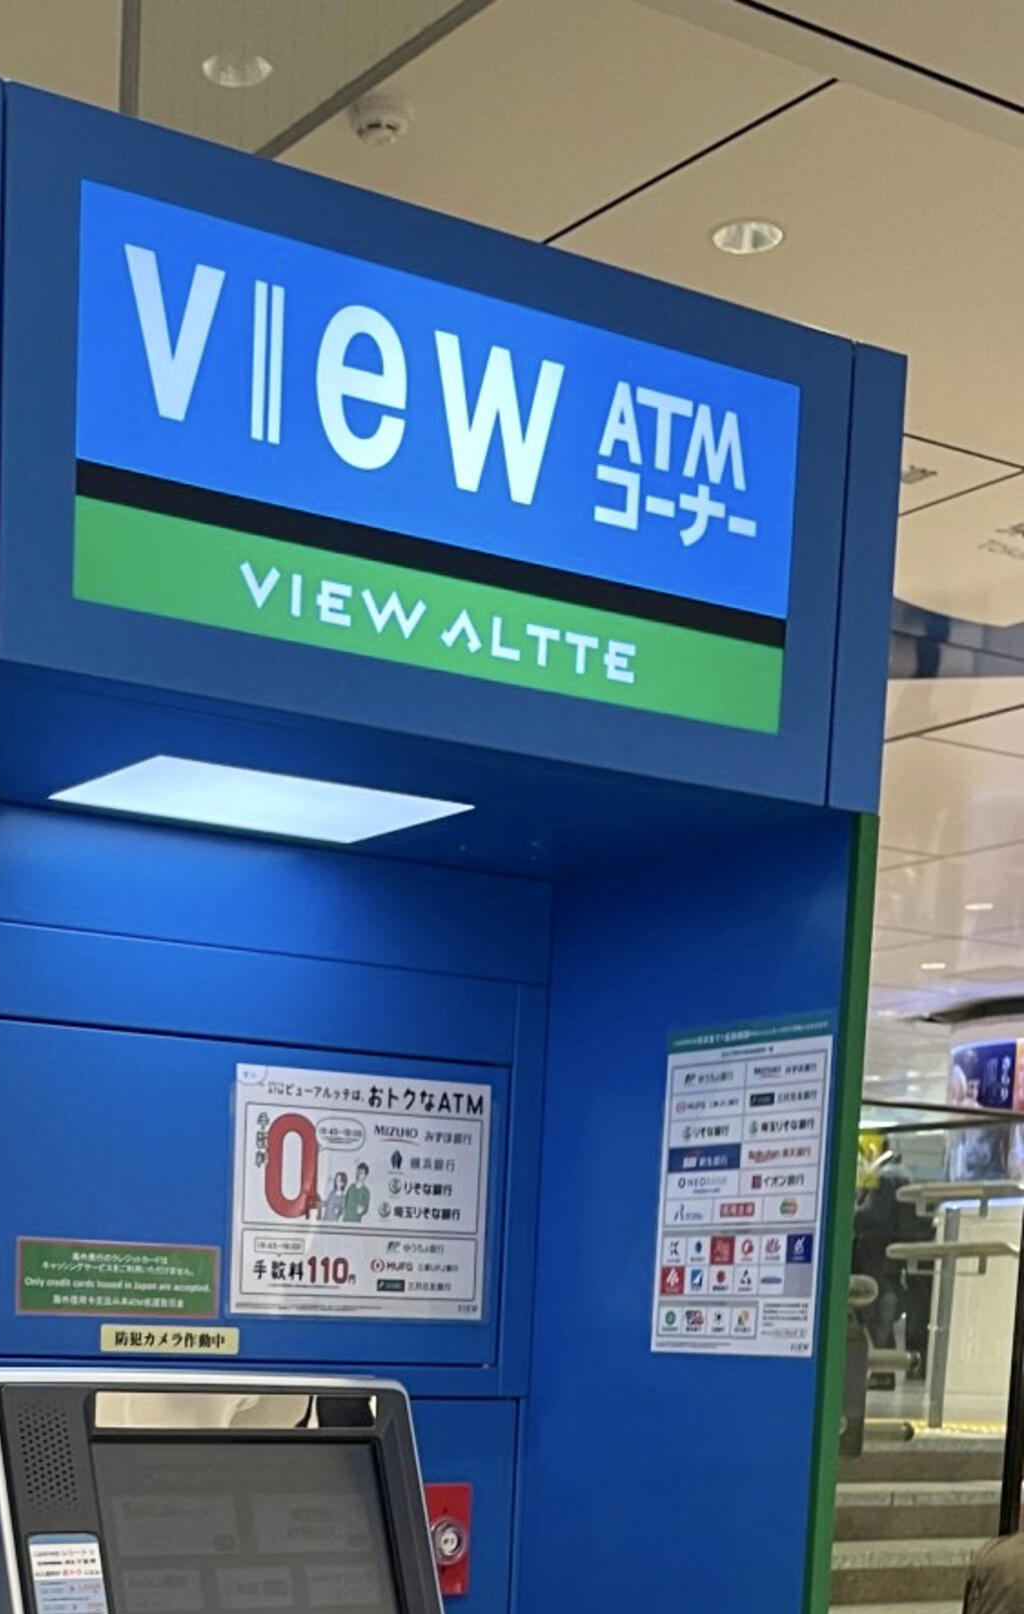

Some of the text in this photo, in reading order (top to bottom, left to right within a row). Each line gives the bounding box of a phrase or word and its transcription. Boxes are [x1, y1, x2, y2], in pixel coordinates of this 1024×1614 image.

[598, 381, 746, 491] ATM
[593, 464, 758, 547] コーナー
[239, 561, 636, 684] VIEW ALTTE
[368, 1085, 484, 1116] おトクなATM
[374, 1124, 418, 1138] MIZUHO
[410, 1157, 456, 1172] 横浜銀行
[404, 1183, 453, 1197] りそな銀行
[394, 1206, 461, 1221] 埼玉りそな銀行
[24, 1277, 44, 1288] Only
[46, 1278, 70, 1288] credit
[73, 1279, 95, 1288] cards
[97, 1280, 123, 1289] issued
[134, 1282, 156, 1291] Japan
[114, 1331, 225, 1349] 防犯カメラ作動中
